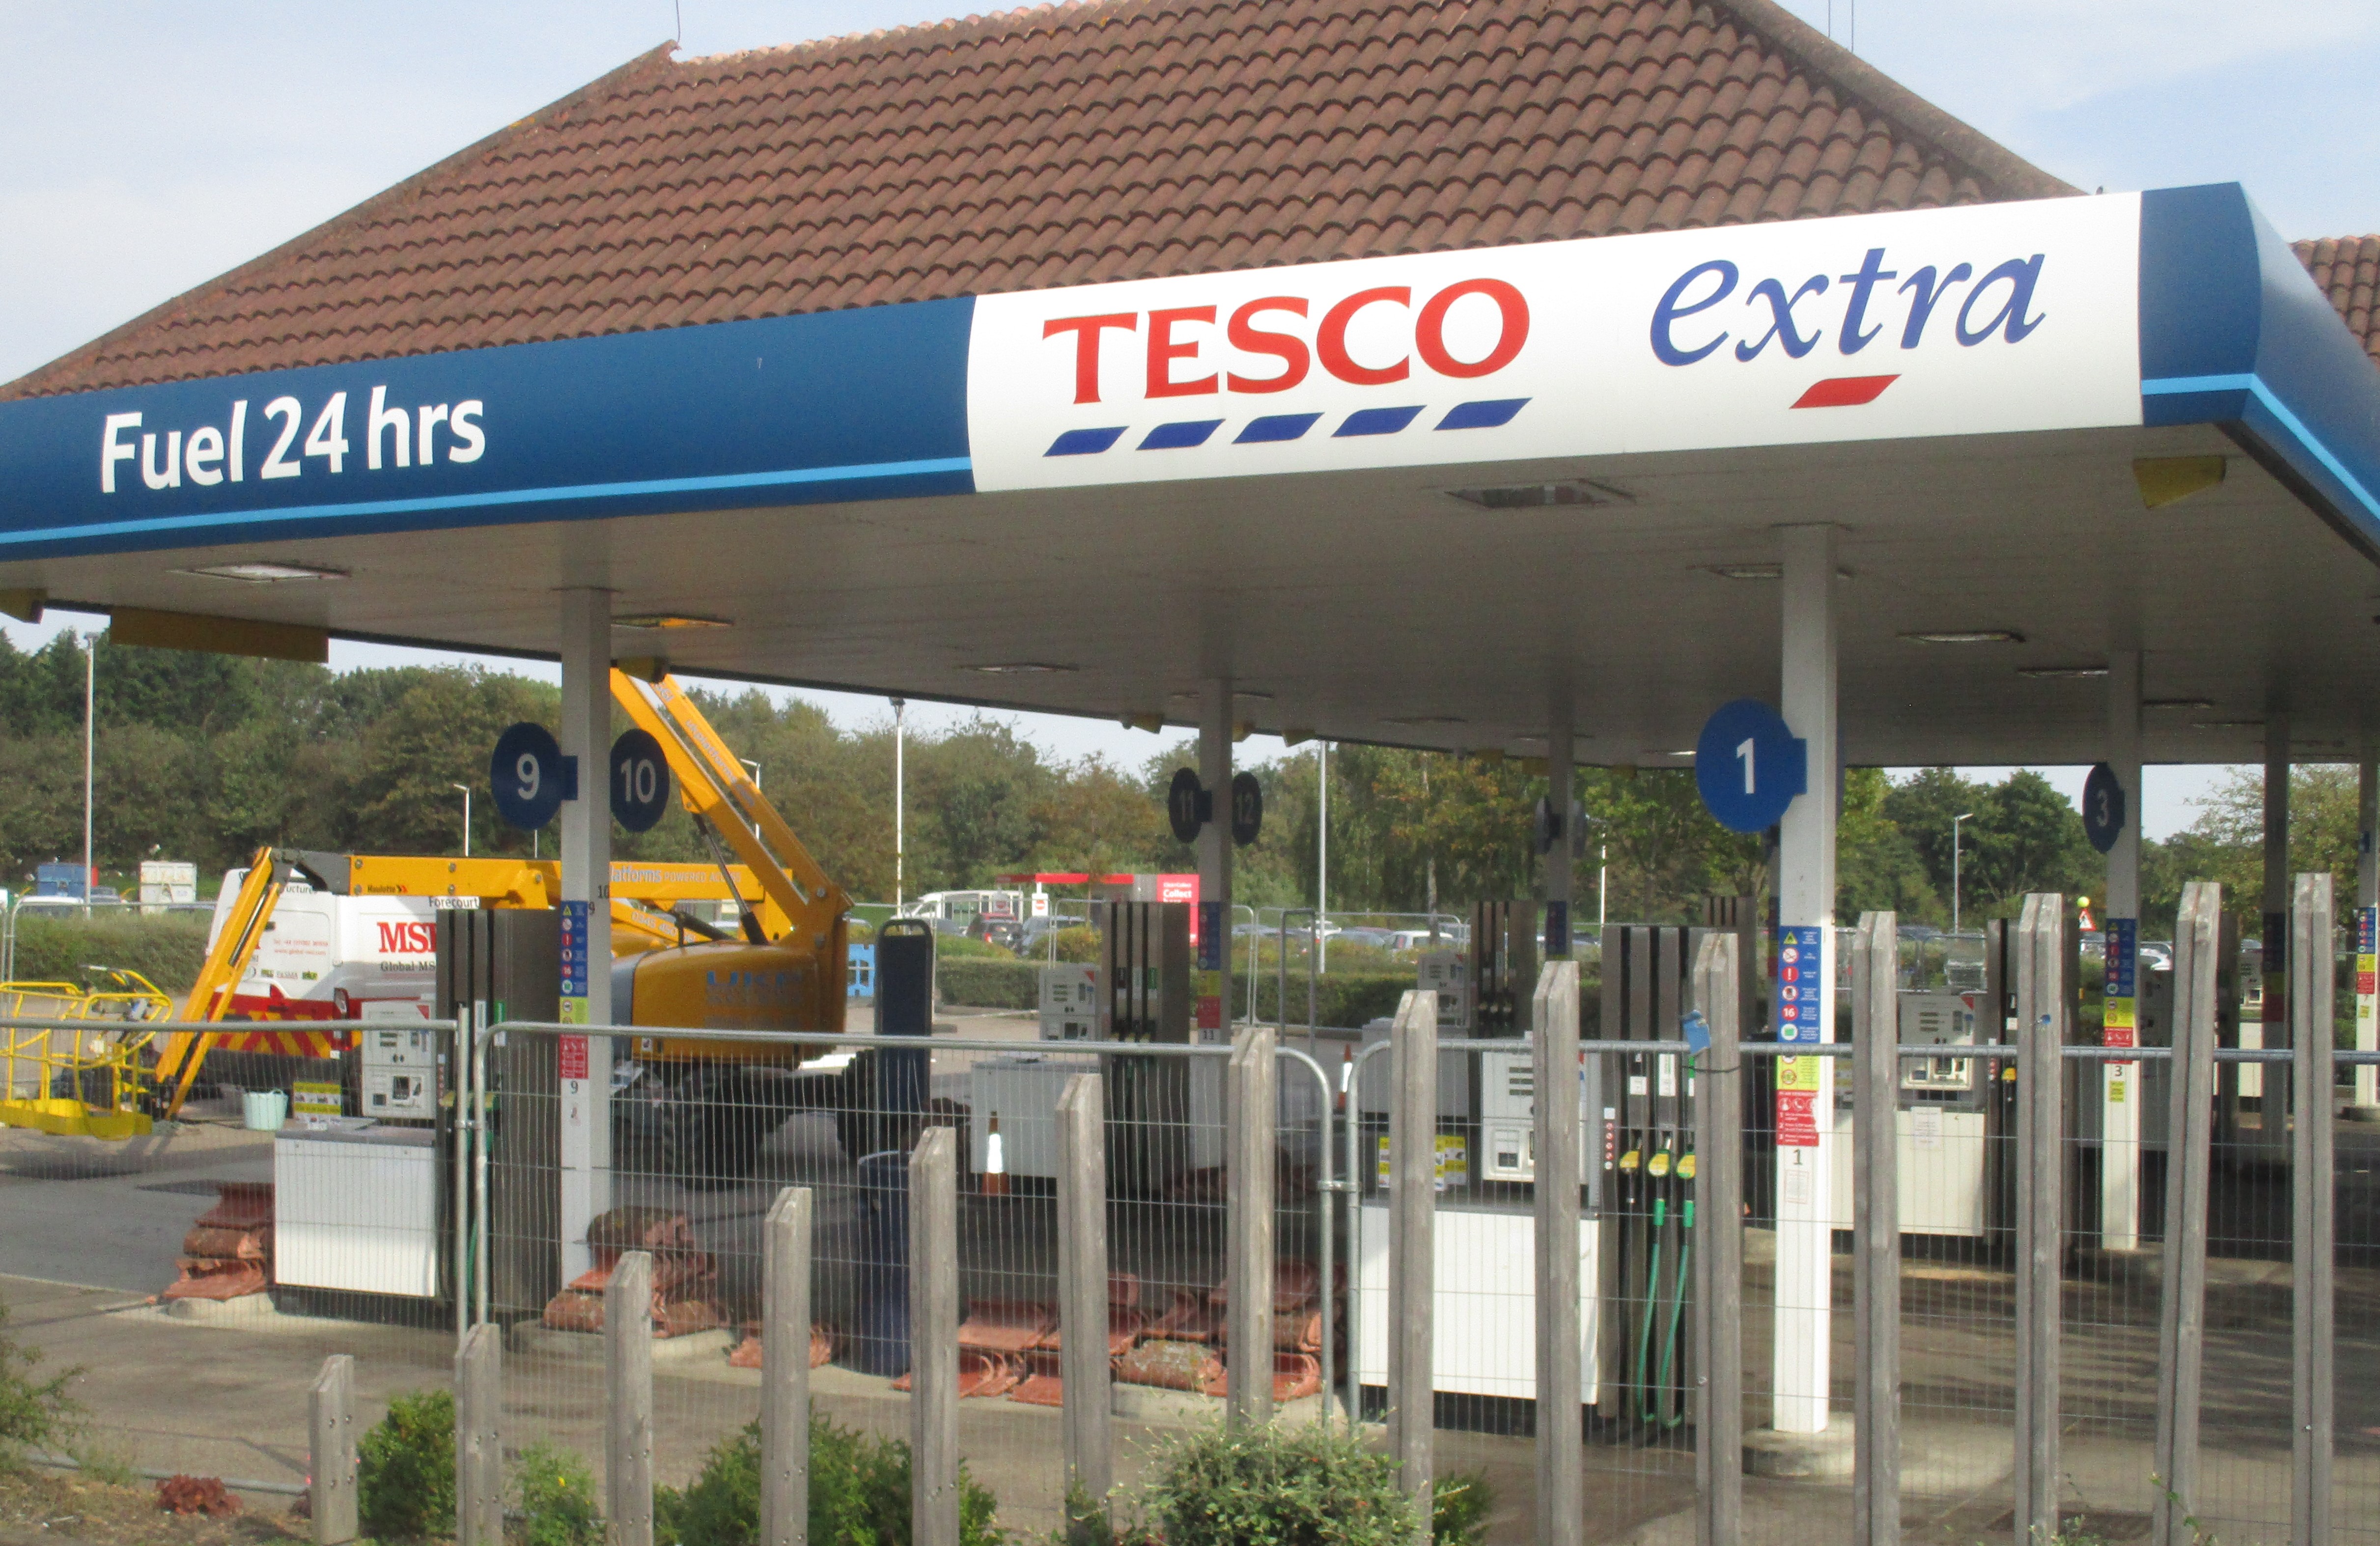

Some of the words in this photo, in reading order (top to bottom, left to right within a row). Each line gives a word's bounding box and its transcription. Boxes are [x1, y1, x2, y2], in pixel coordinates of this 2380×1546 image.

[1042, 278, 1530, 404] TESCO
[1650, 248, 2046, 367] extra
[101, 400, 248, 494] Fuel
[261, 392, 349, 479] 24
[367, 385, 486, 470] hrs
[1736, 738, 1755, 794] 1
[516, 753, 540, 800] 9
[620, 758, 656, 804] 10
[2097, 789, 2110, 827] 3
[611, 866, 662, 883] latforms
[664, 871, 706, 882] POWERED
[1163, 889, 1192, 898] Collect
[428, 897, 479, 908] Forecourt
[381, 961, 415, 971] Global
[1783, 1008, 1795, 1018] 16
[2114, 1065, 2123, 1076] 3
[570, 1081, 579, 1095] 9
[1793, 1149, 1803, 1165] 1
